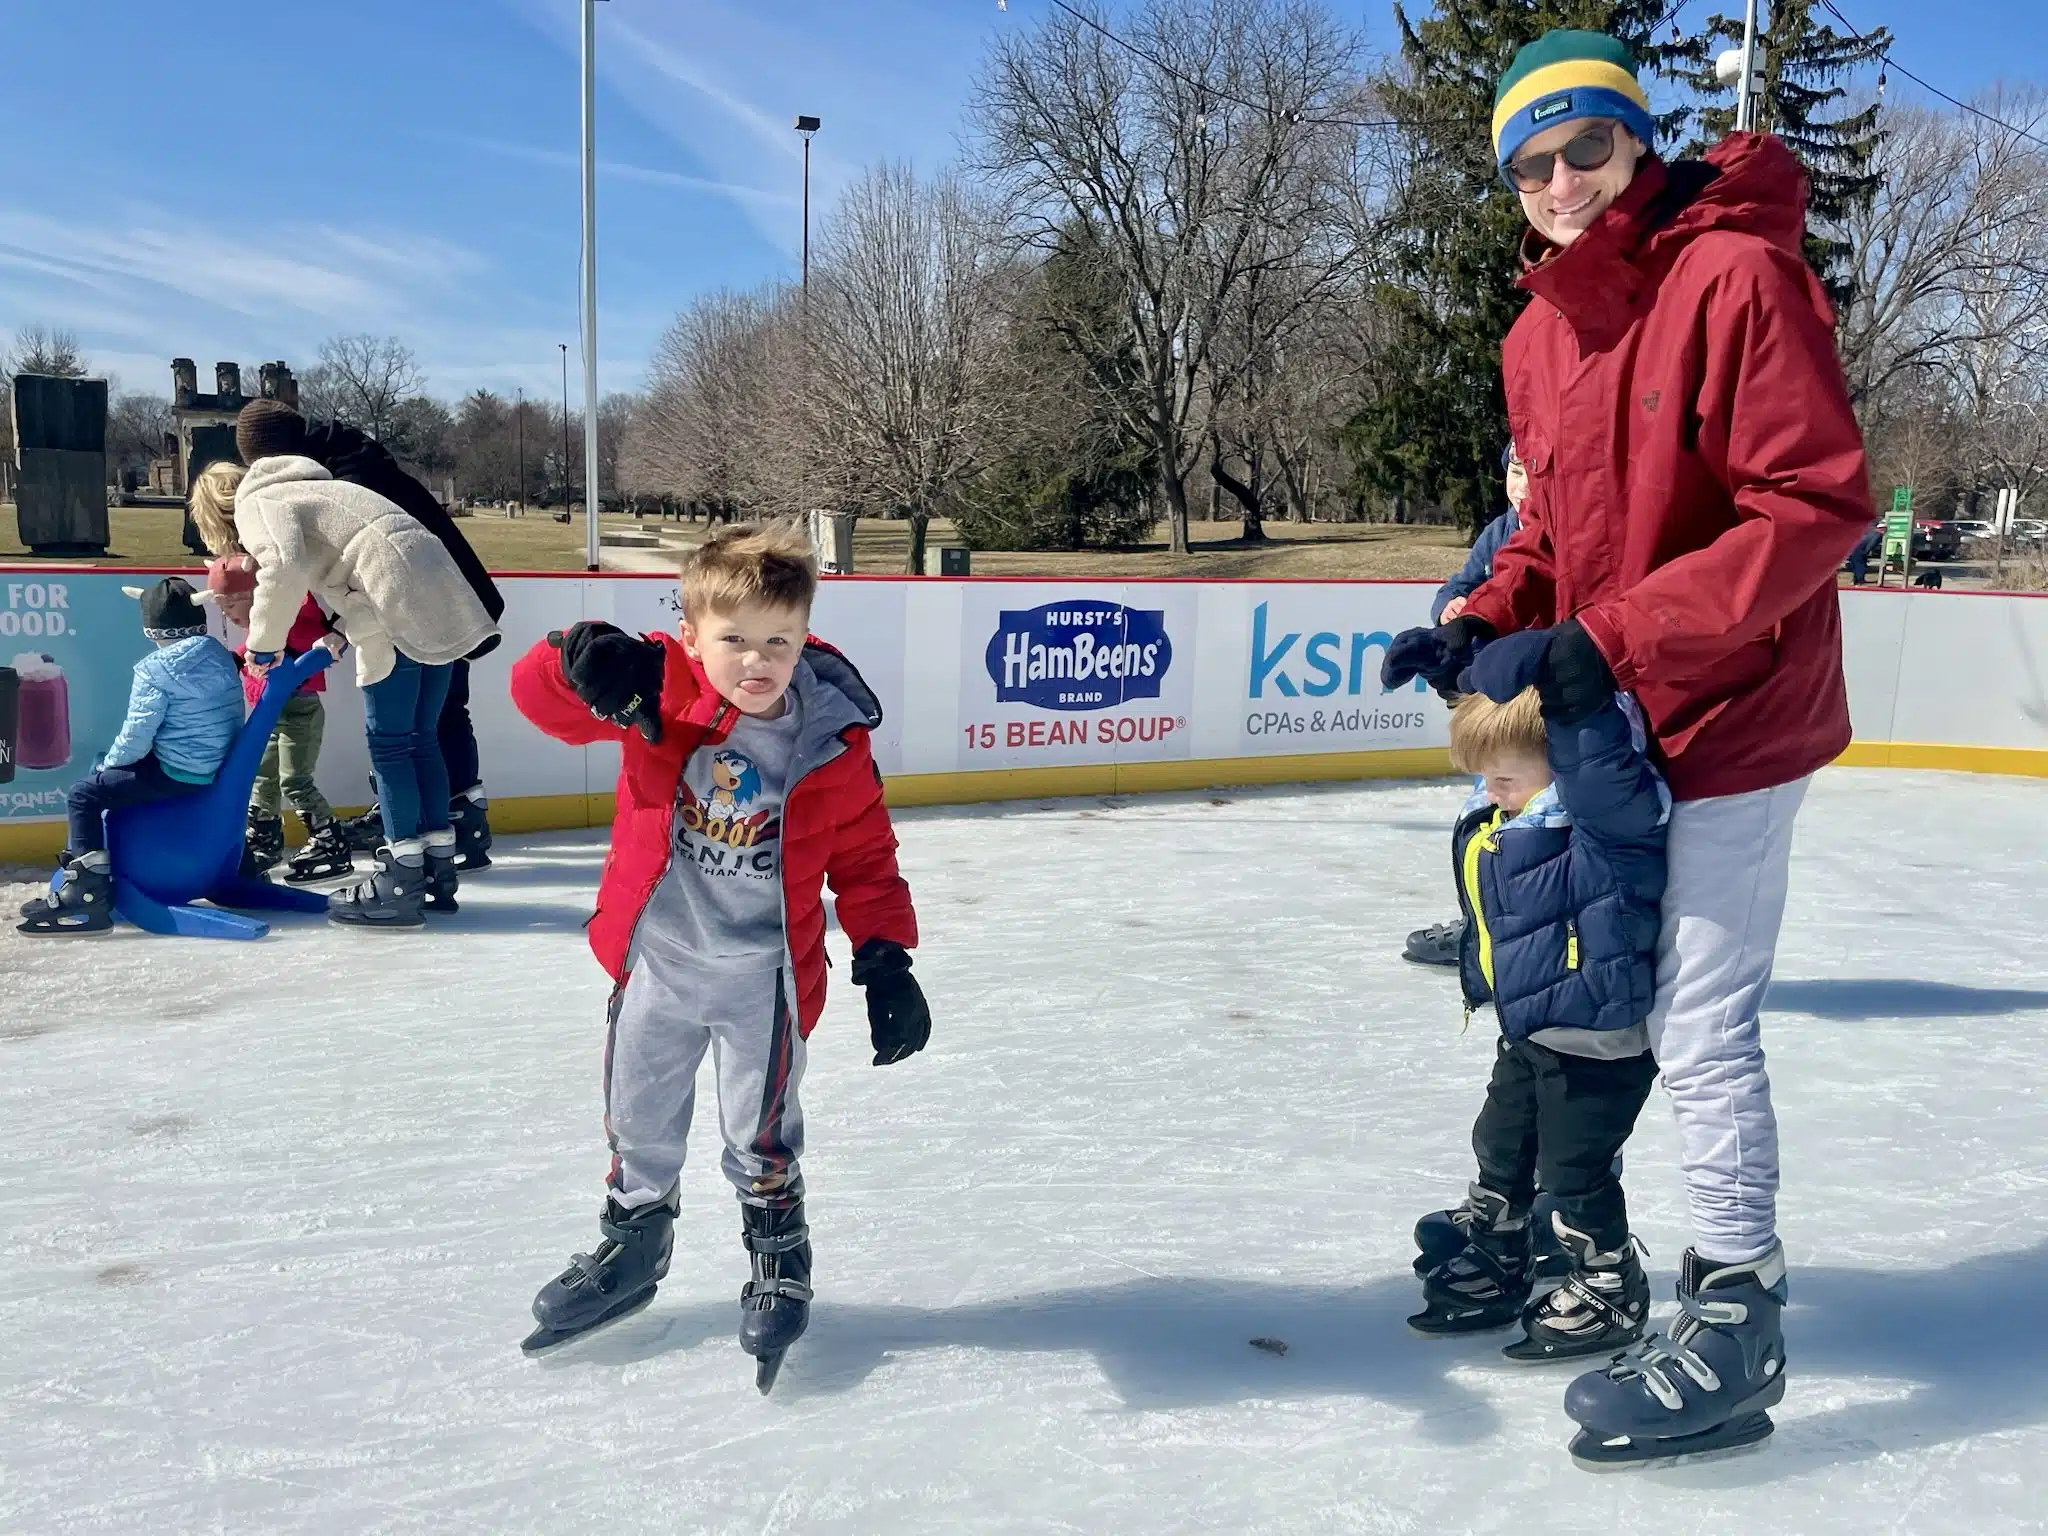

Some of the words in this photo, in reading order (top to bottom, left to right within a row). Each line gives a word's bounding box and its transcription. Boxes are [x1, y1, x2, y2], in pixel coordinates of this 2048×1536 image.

[8, 584, 70, 609] FOR
[0, 611, 77, 636] OOD.
[1046, 612, 1123, 626] HURST'S
[1059, 692, 1103, 704] BRAND
[1246, 712, 1305, 735] CPAs
[1310, 710, 1326, 732] &
[1330, 708, 1425, 731] Advisors
[964, 724, 996, 749] 15
[1006, 720, 1088, 747] BEAN
[697, 864, 738, 877] THAN
[744, 872, 773, 880] YOU
[1569, 1283, 1586, 1297] LAKE
[1582, 1293, 1606, 1311] PLACID
